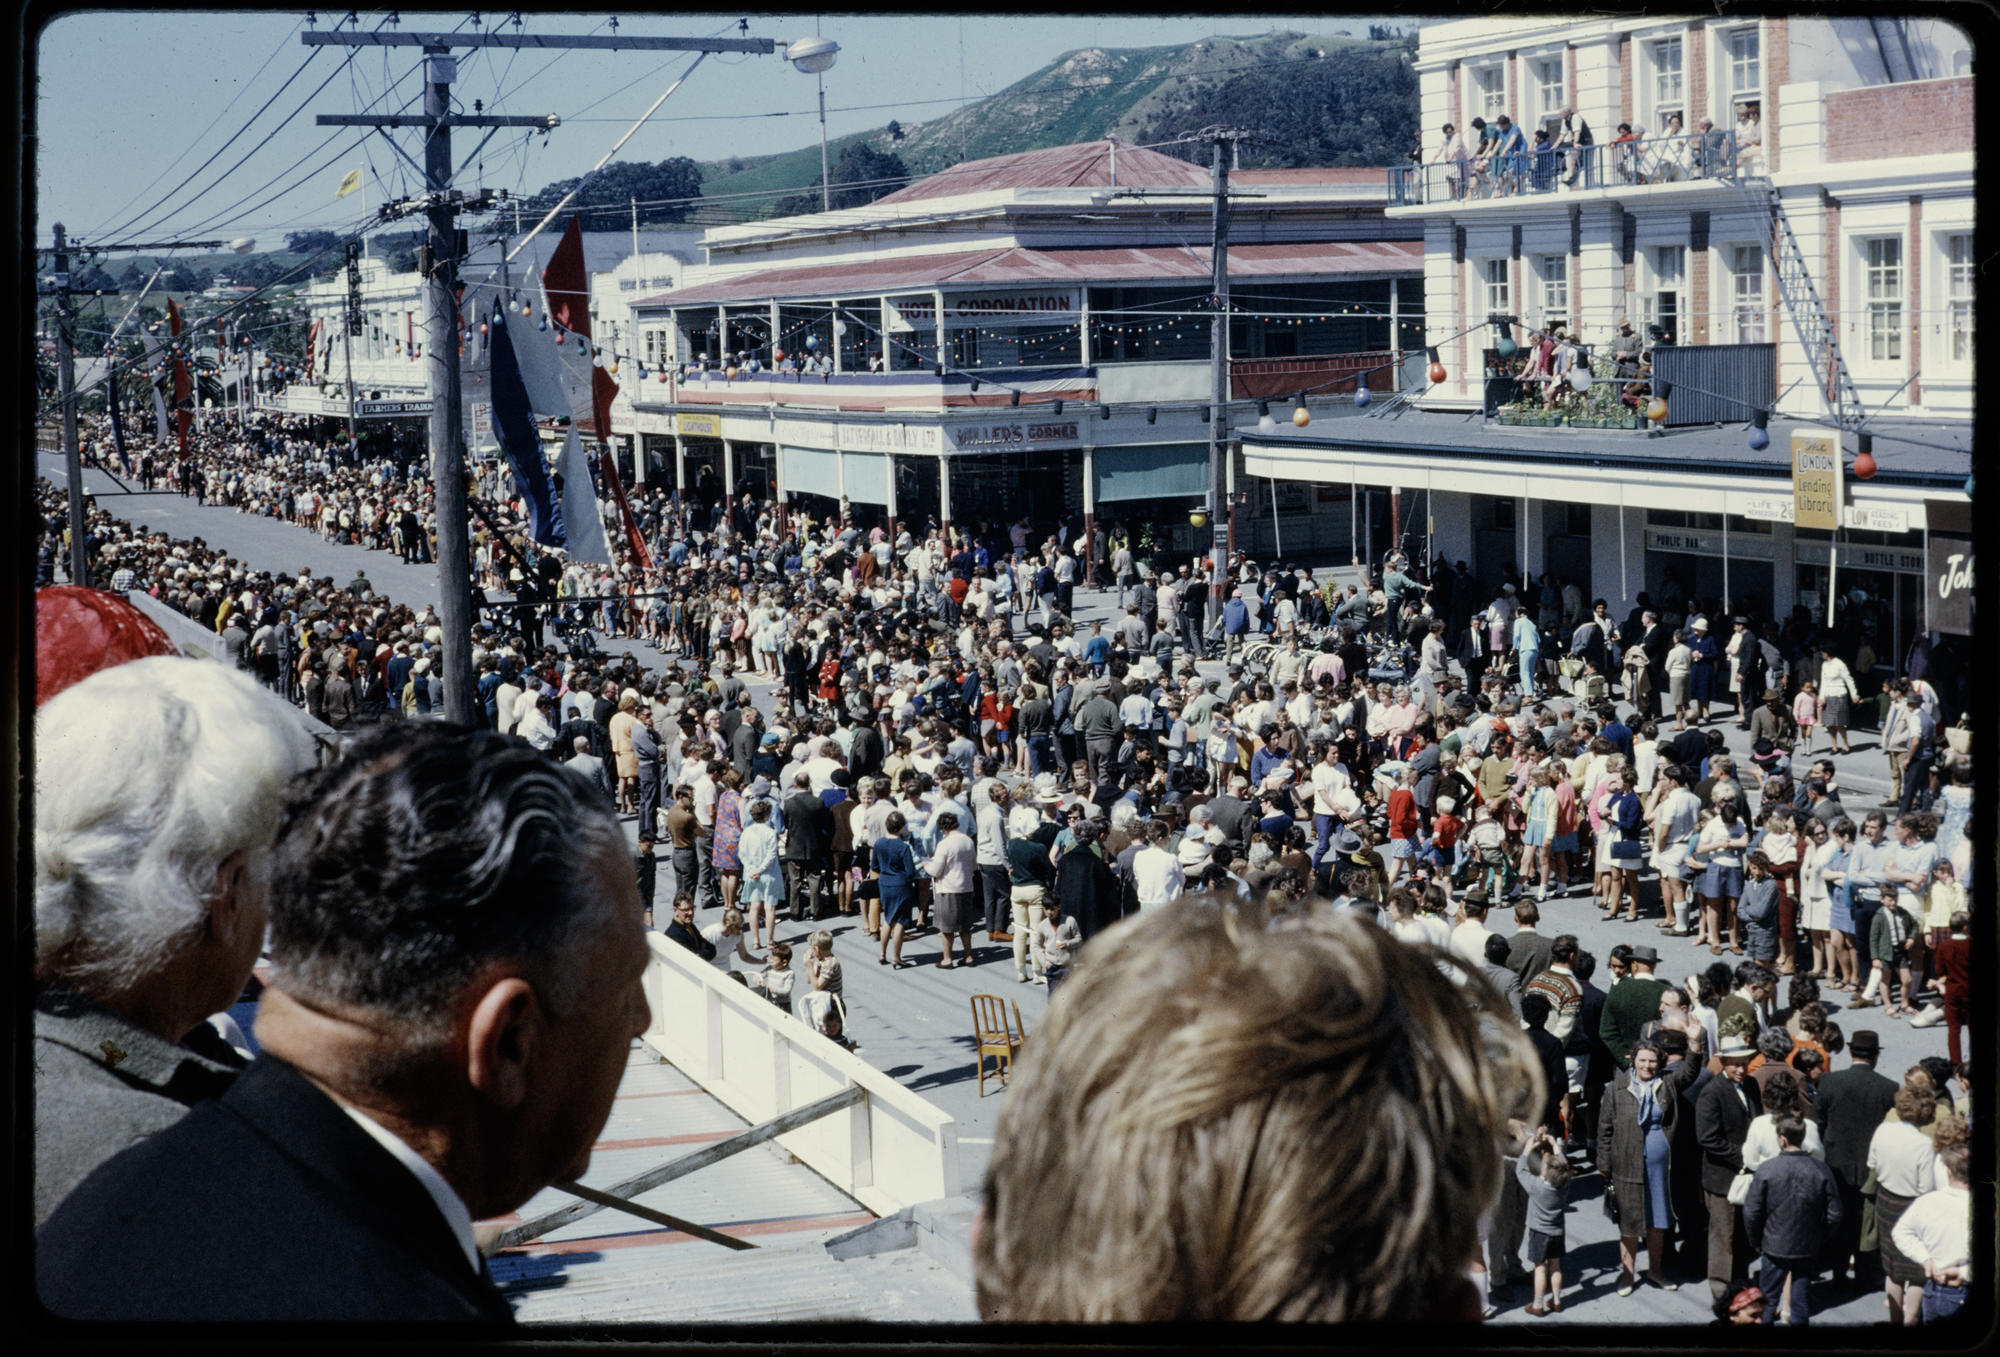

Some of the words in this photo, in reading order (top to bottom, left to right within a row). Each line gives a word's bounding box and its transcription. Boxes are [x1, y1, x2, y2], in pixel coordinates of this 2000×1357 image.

[956, 296, 1070, 317] CORONATION
[364, 404, 401, 413] FARMERS
[404, 403, 433, 411] TRADIN
[1027, 424, 1079, 440] CORNER
[1796, 448, 1833, 474] LONDON
[1798, 479, 1832, 498] Lending
[1752, 501, 1772, 509] LIFE
[1798, 496, 1833, 517] Library
[1851, 510, 1868, 526] LOW
[1872, 520, 1893, 528] FEES
[1656, 535, 1680, 547] PUBLIC
[1684, 537, 1699, 548] BAR
[1864, 552, 1895, 567] BOTTLE
